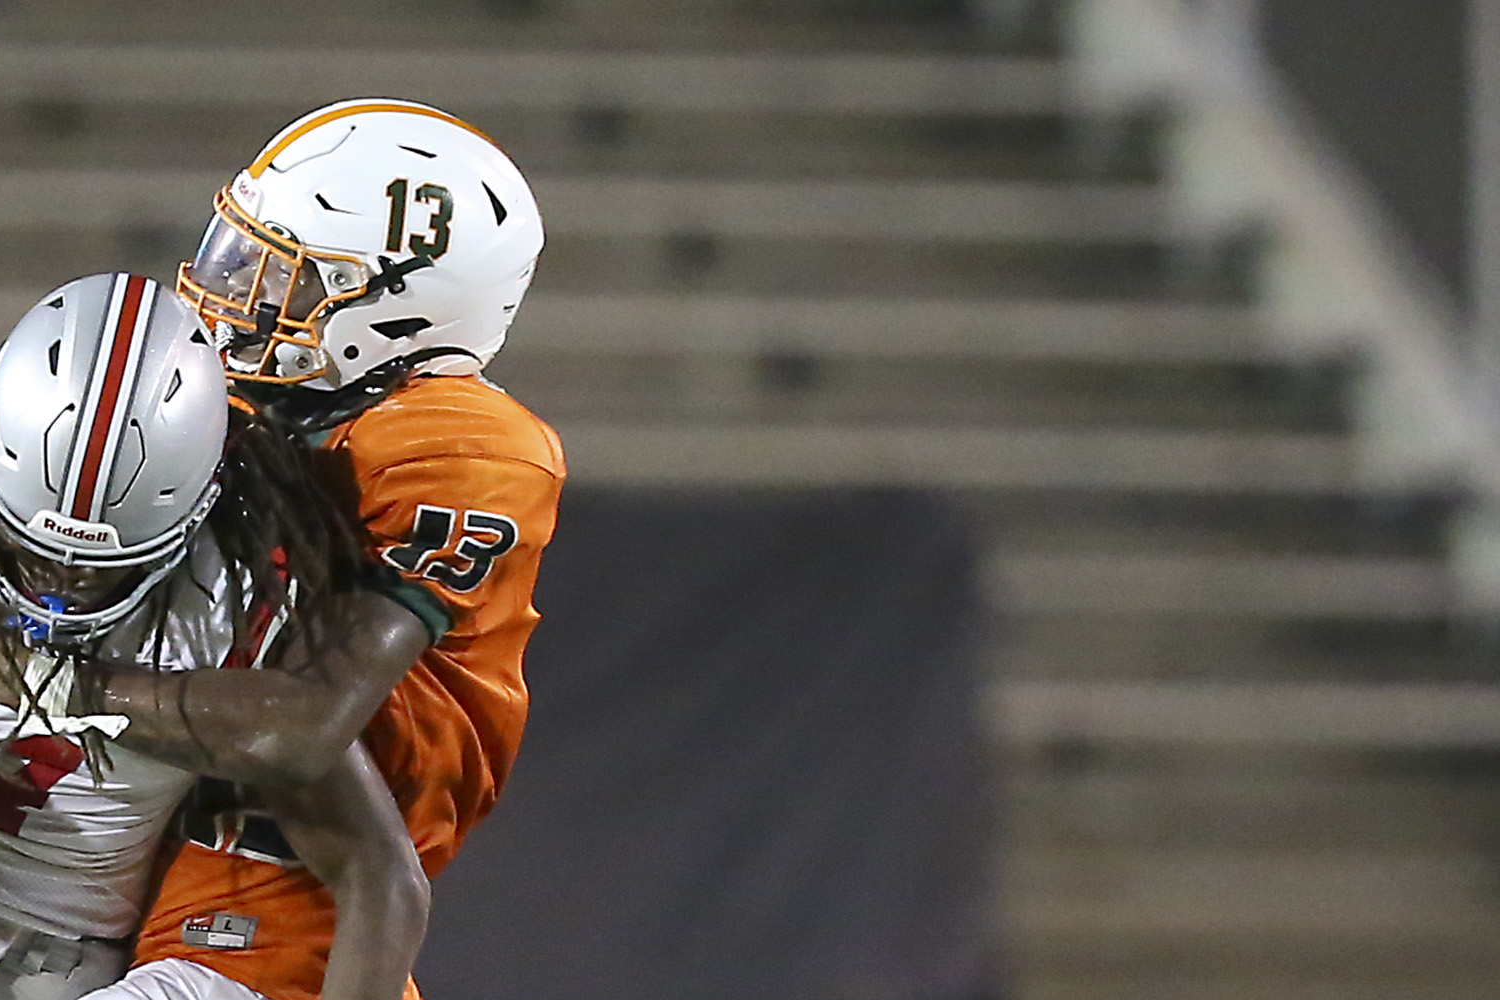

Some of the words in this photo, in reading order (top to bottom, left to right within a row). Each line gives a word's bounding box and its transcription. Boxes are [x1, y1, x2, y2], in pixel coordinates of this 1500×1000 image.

[385, 177, 454, 260] 13
[43, 518, 109, 542] Riddell
[380, 504, 519, 594] 13
